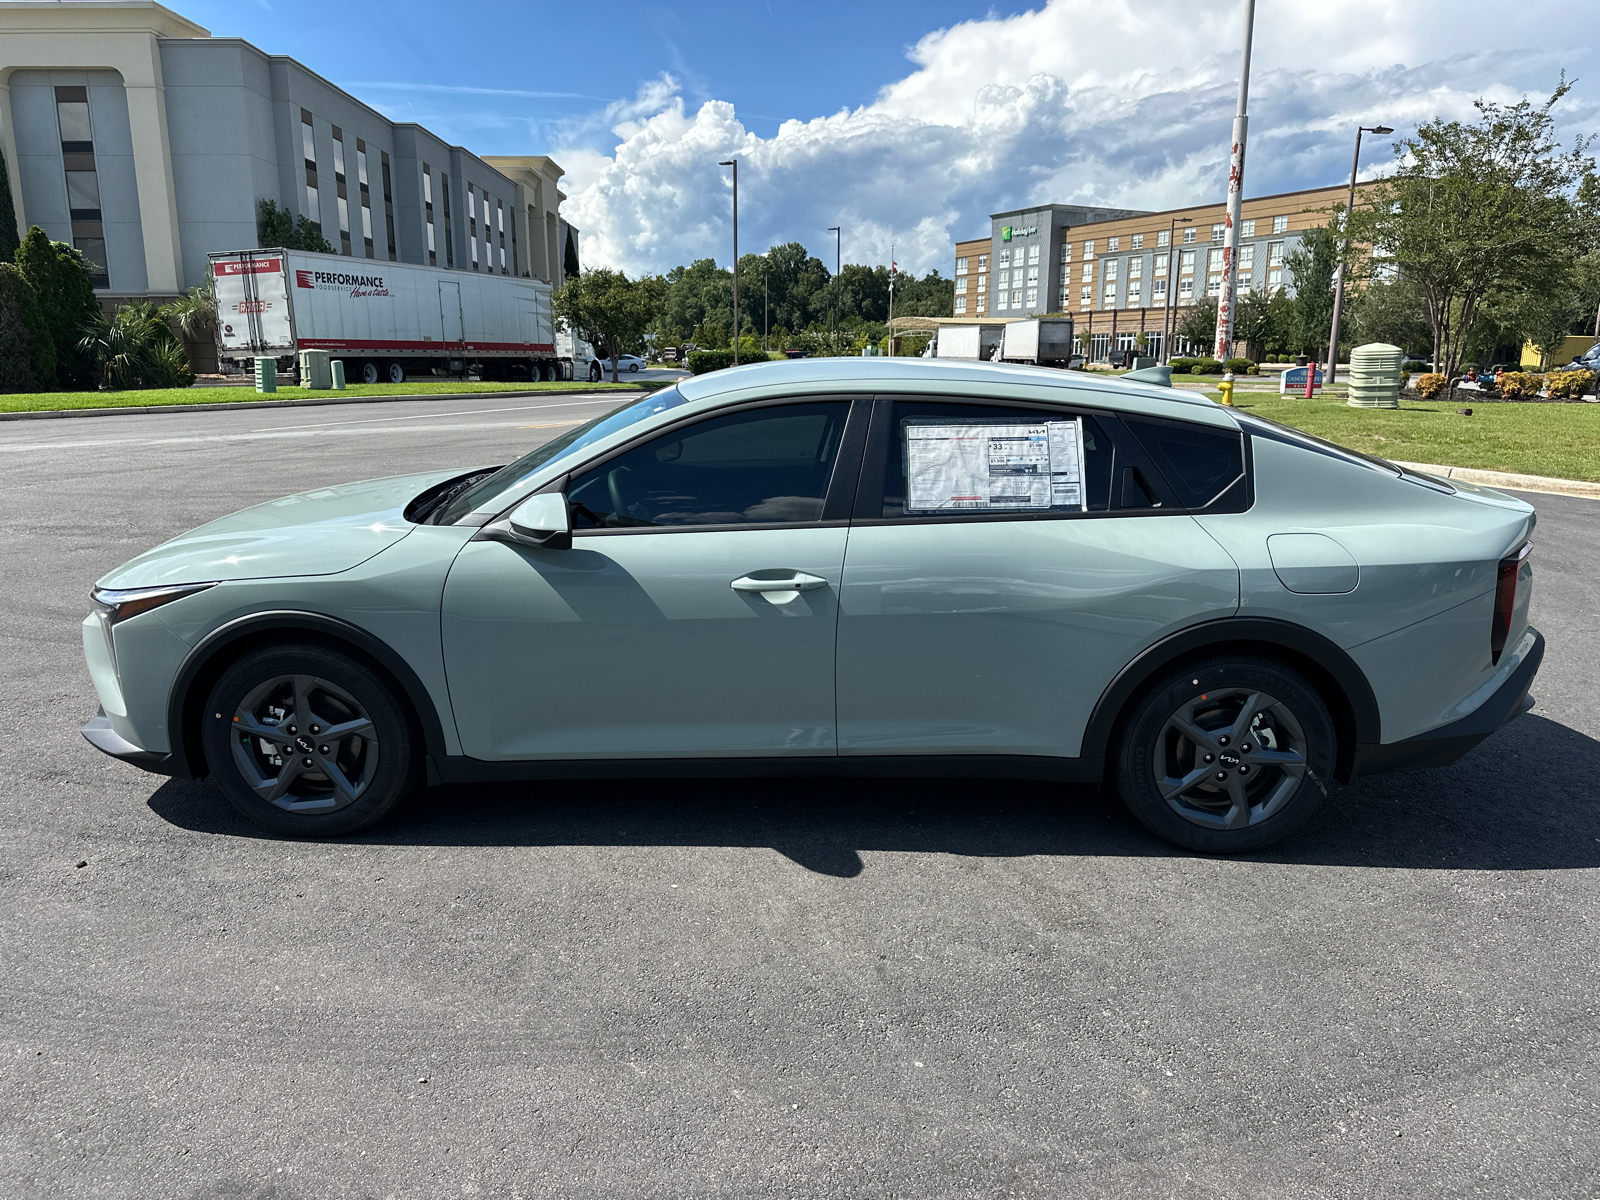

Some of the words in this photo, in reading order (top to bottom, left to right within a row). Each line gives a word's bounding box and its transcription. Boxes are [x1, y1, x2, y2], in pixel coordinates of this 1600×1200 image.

[233, 261, 270, 270] PERFORMANCE
[314, 271, 384, 288] PERFORMANCE
[315, 284, 352, 292] FOODSERVICE
[349, 286, 368, 298] Have
[992, 443, 1003, 451] 33
[223, 661, 270, 700] SOLUS
[1243, 671, 1299, 700] SOLUS
[1134, 746, 1153, 804] KUMHO
